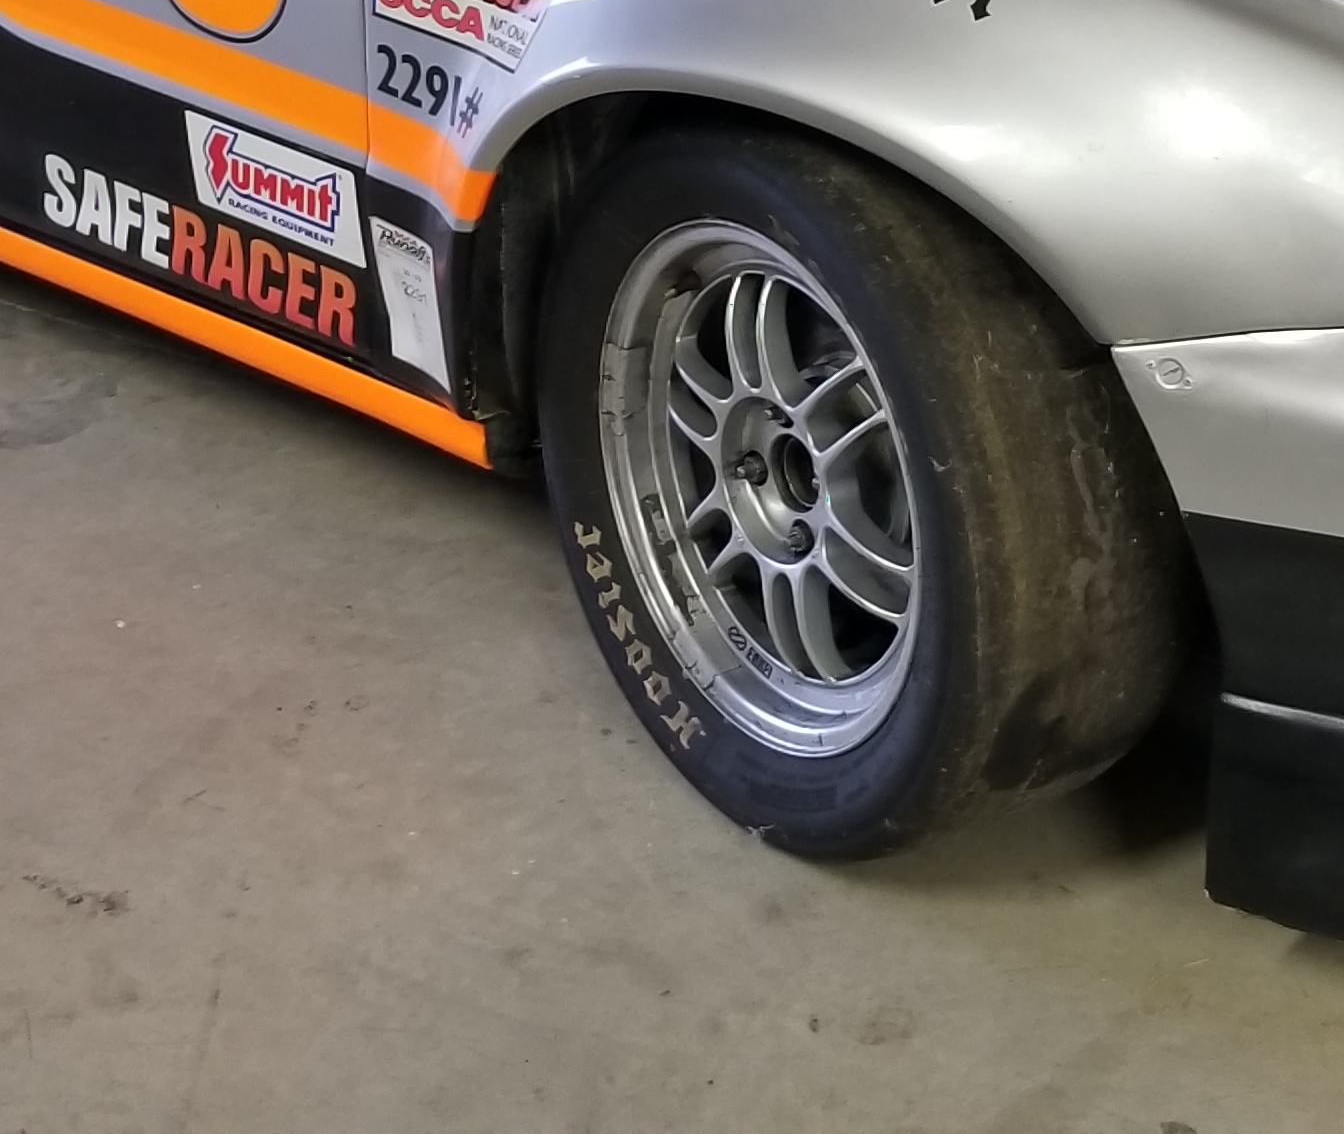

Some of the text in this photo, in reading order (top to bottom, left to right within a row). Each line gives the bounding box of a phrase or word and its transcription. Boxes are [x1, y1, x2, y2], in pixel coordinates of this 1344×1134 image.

[43, 152, 357, 348] SAFERACER
[227, 197, 269, 221] RACING
[271, 215, 336, 247] EQUIPMENT
[572, 520, 708, 751] Hoosier
